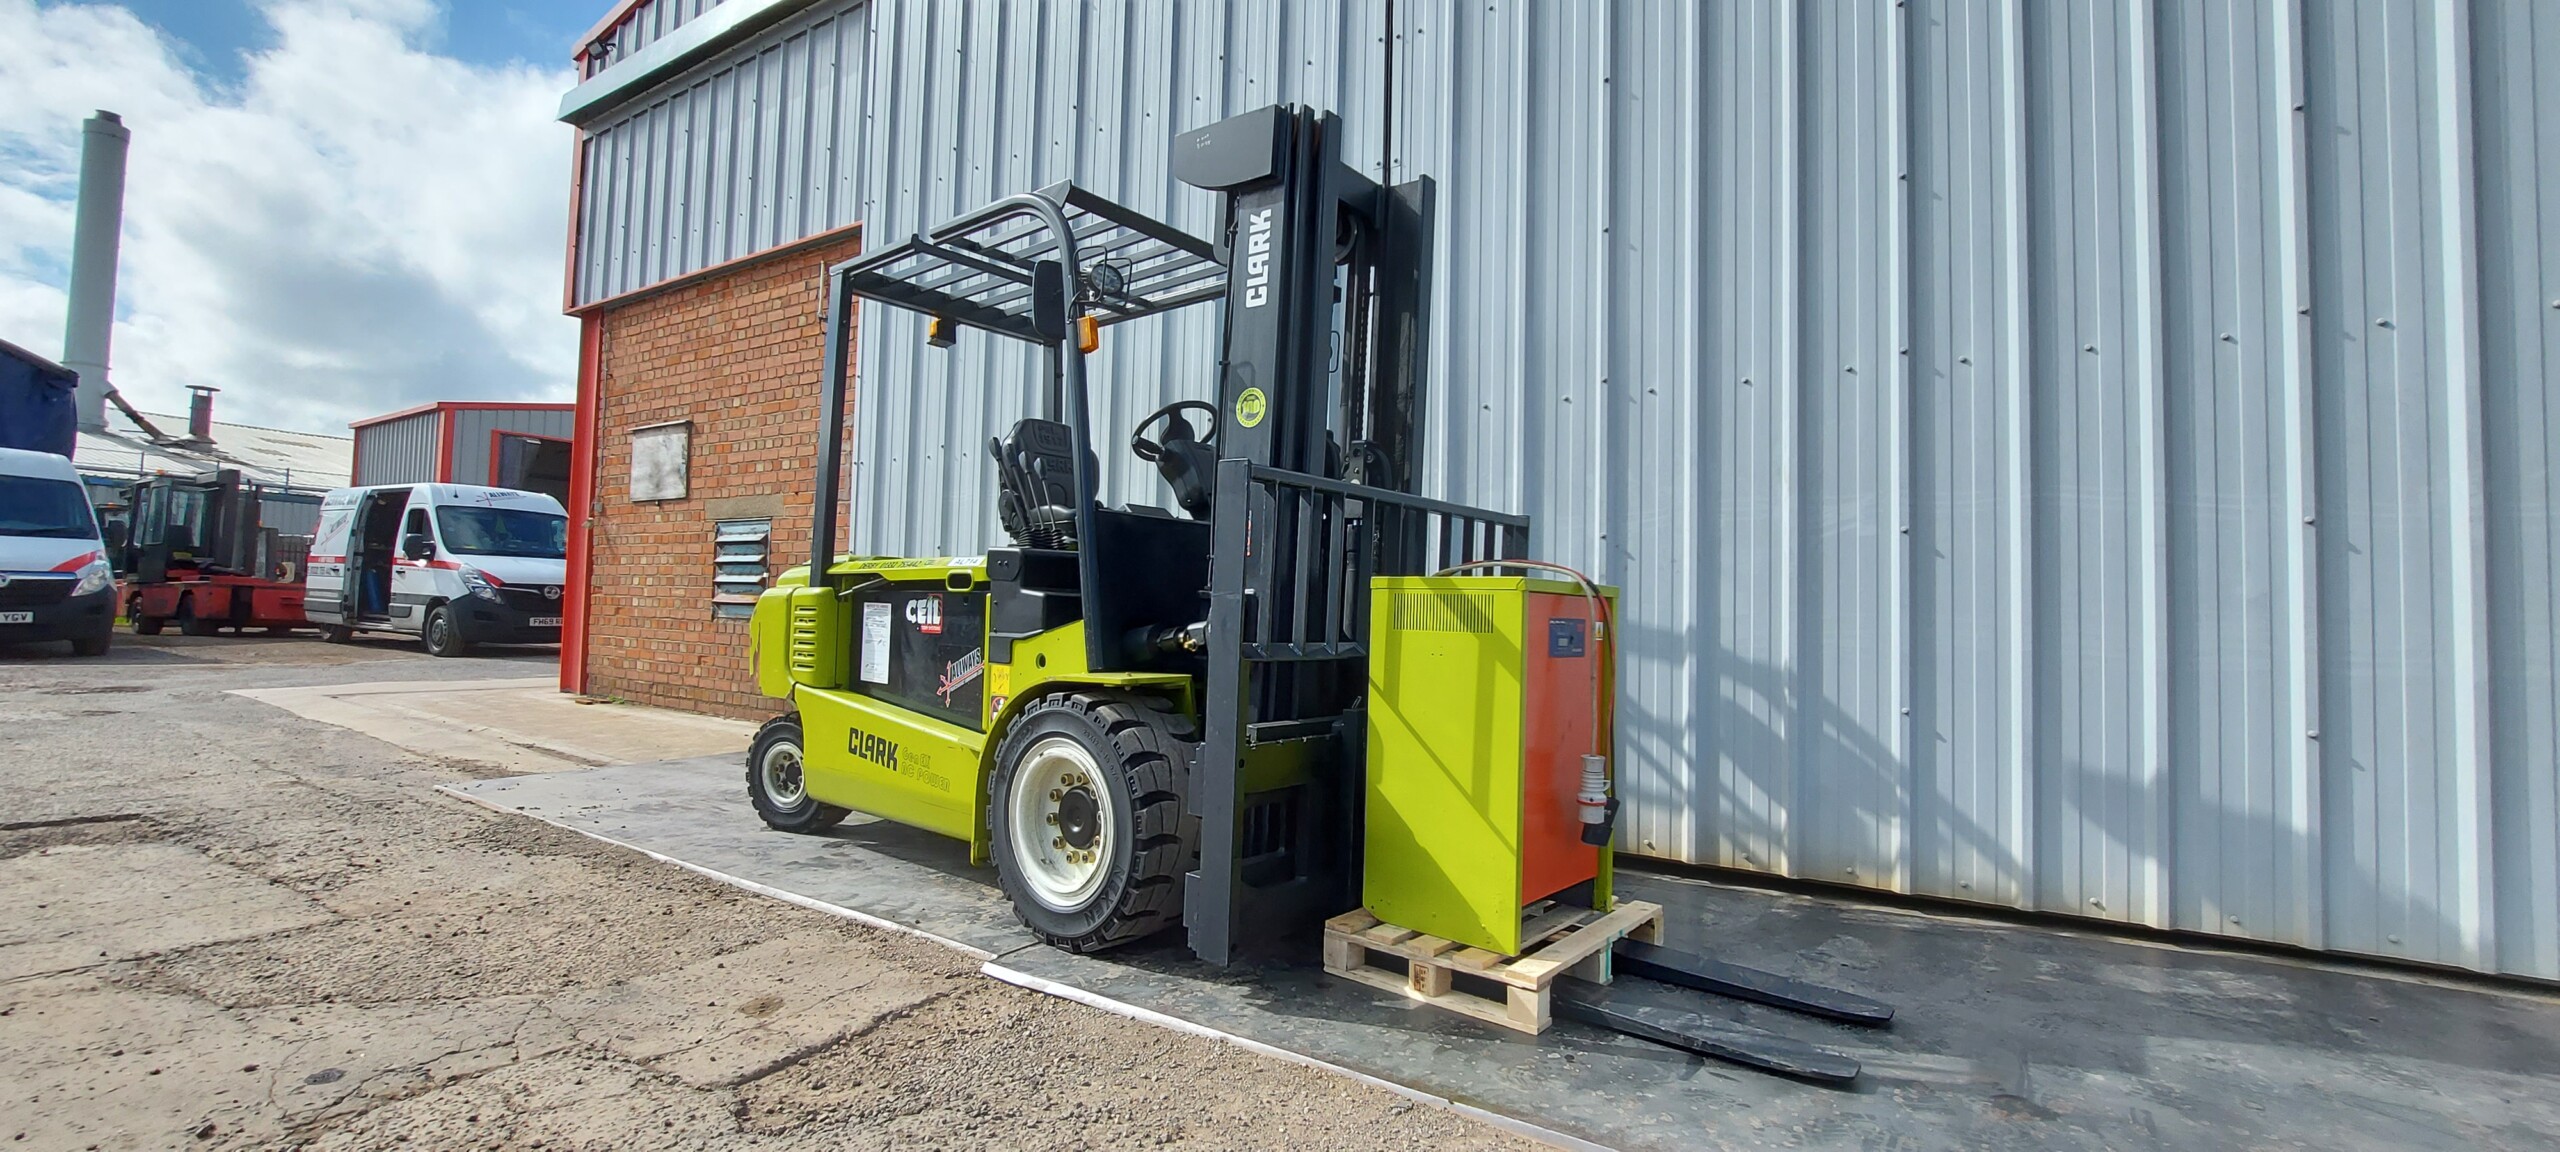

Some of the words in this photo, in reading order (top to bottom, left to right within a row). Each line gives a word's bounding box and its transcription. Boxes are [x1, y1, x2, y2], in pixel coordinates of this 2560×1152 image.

[1246, 208, 1272, 309] CLARK
[951, 647, 982, 681] ALLWAYS
[848, 726, 899, 772] CLARK
[916, 767, 950, 793] POWER
